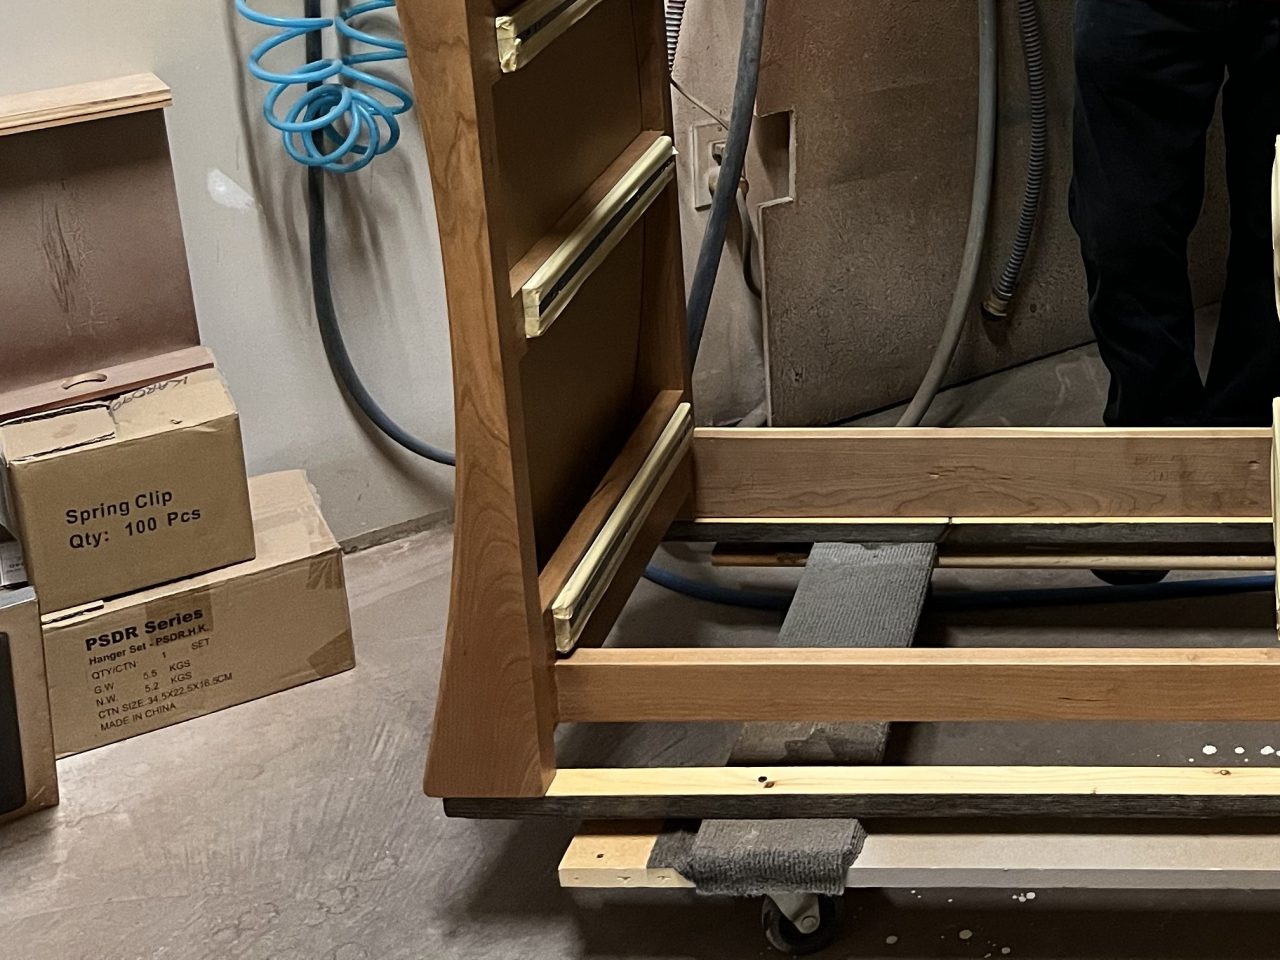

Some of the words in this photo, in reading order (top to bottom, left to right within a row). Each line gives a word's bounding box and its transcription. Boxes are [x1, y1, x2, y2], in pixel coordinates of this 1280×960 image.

[65, 500, 130, 525] Spring
[135, 490, 173, 508] Clip
[69, 530, 109, 549] Qty:
[124, 517, 157, 536] 100
[167, 509, 201, 526] Pcs
[85, 626, 139, 651] PSDR
[144, 609, 204, 634] Series
[89, 649, 126, 665] Hanger
[129, 642, 147, 654] Set
[191, 637, 210, 650] SET
[169, 659, 191, 672] KGS
[144, 681, 159, 693] 5.2
[170, 671, 192, 684] KGS
[98, 706, 120, 720] CTN
[100, 715, 129, 731] MADE
[132, 712, 143, 723] IN
[144, 701, 177, 718] CHINA
